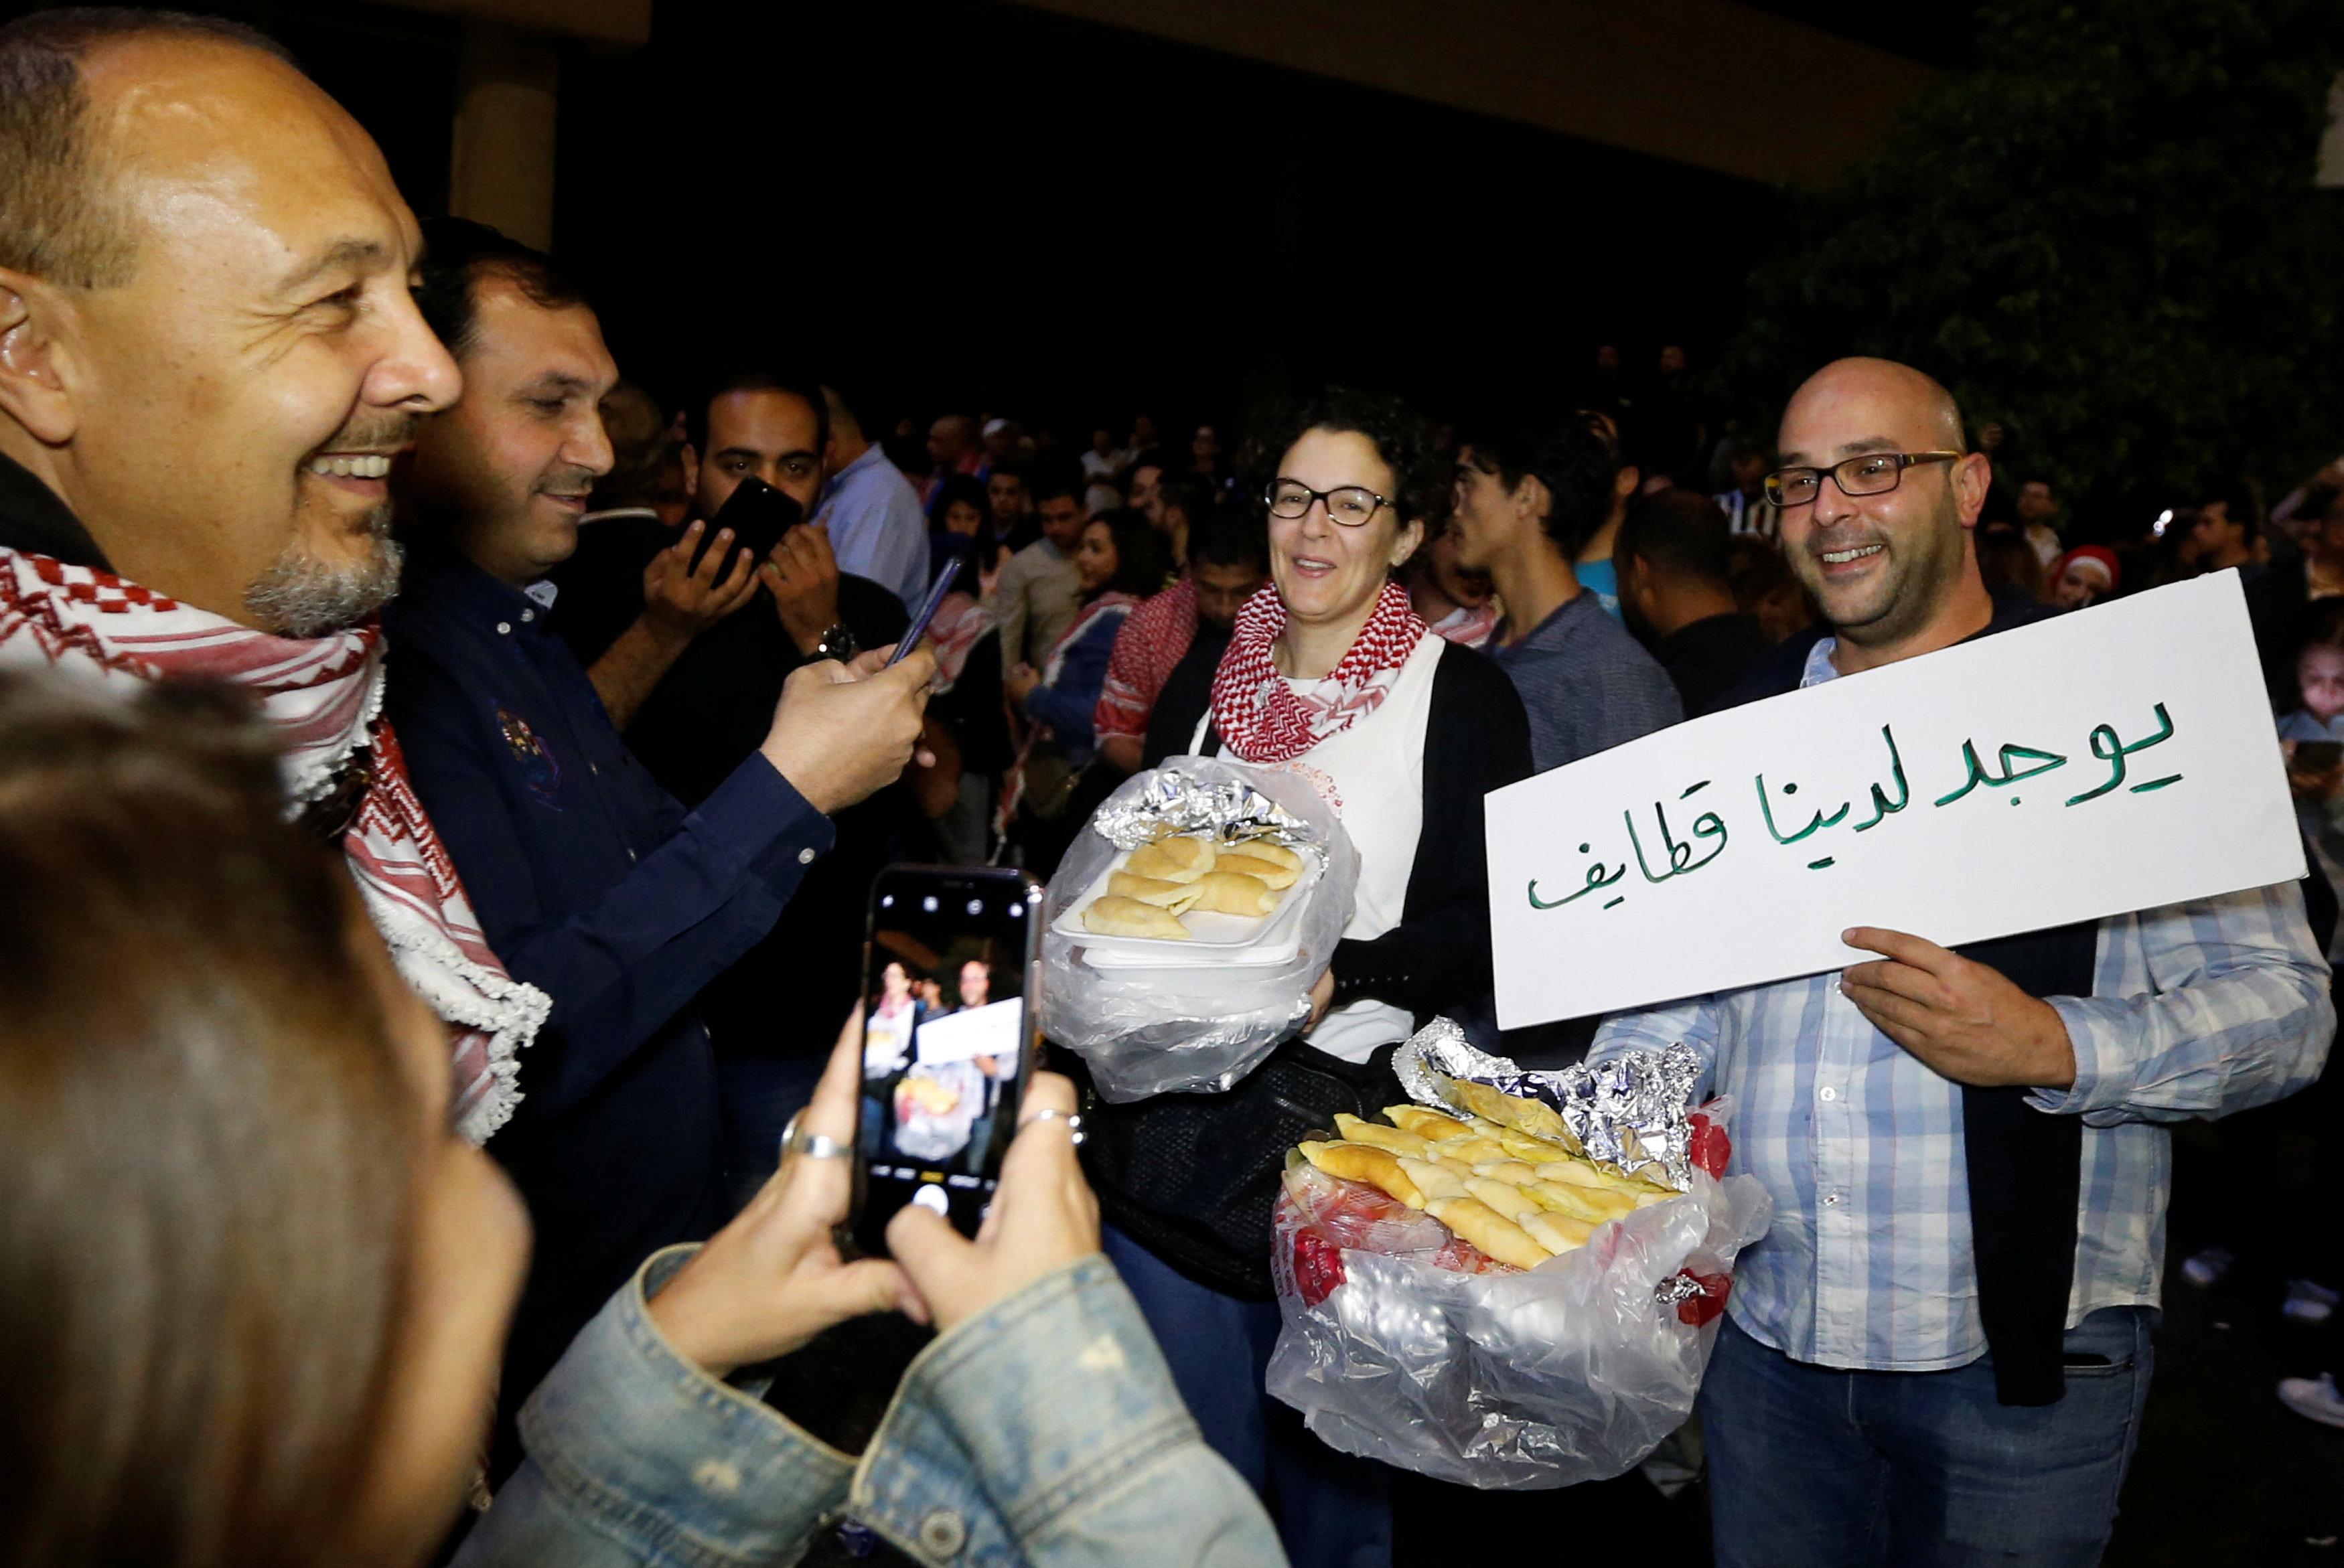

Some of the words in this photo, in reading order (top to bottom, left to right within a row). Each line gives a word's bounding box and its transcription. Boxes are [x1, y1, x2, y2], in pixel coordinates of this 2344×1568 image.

[1755, 724, 1910, 870] لدينا
[1934, 702, 2183, 807] يوجد
[1528, 781, 1728, 910] قطايف
